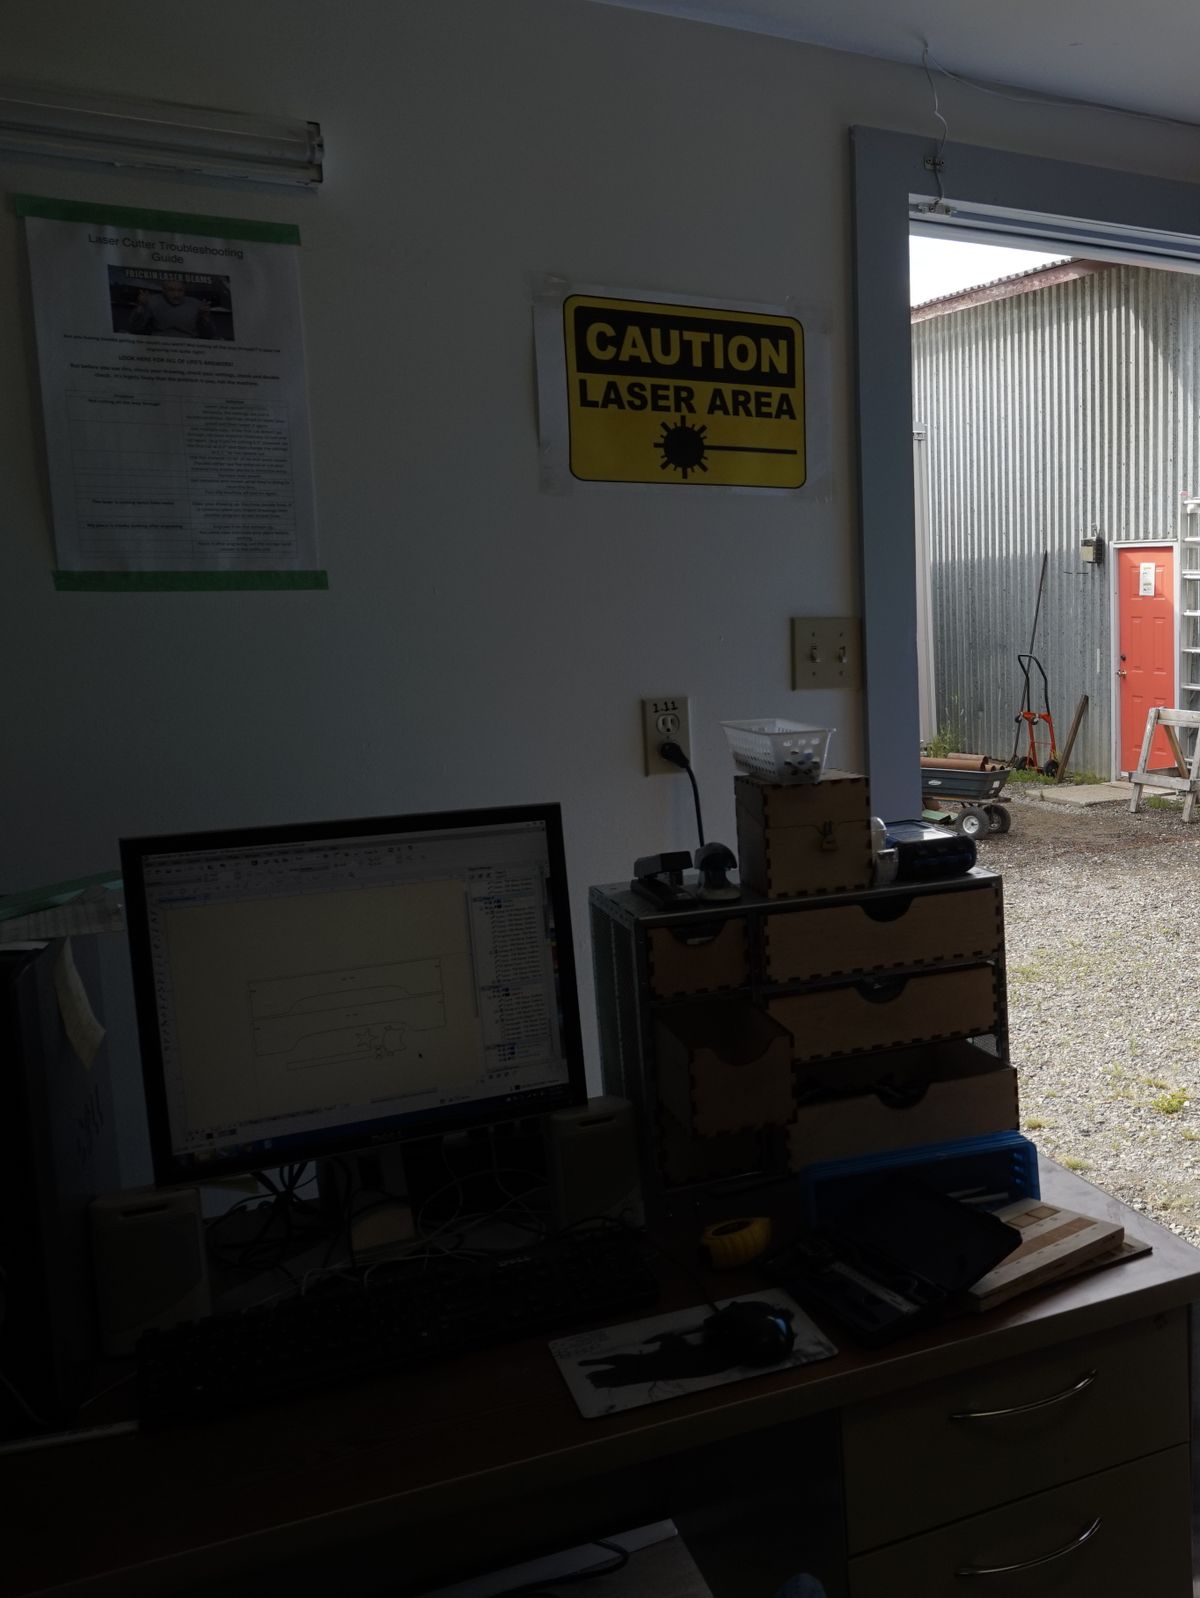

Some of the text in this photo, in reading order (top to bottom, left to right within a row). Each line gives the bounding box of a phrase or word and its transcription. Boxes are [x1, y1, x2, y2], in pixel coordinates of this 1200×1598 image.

[122, 237, 156, 249] Cutter
[159, 241, 244, 260] Troubleshooting
[151, 252, 184, 264] Guide
[585, 321, 789, 375] CAUTION
[579, 378, 797, 421] LASER AREA
